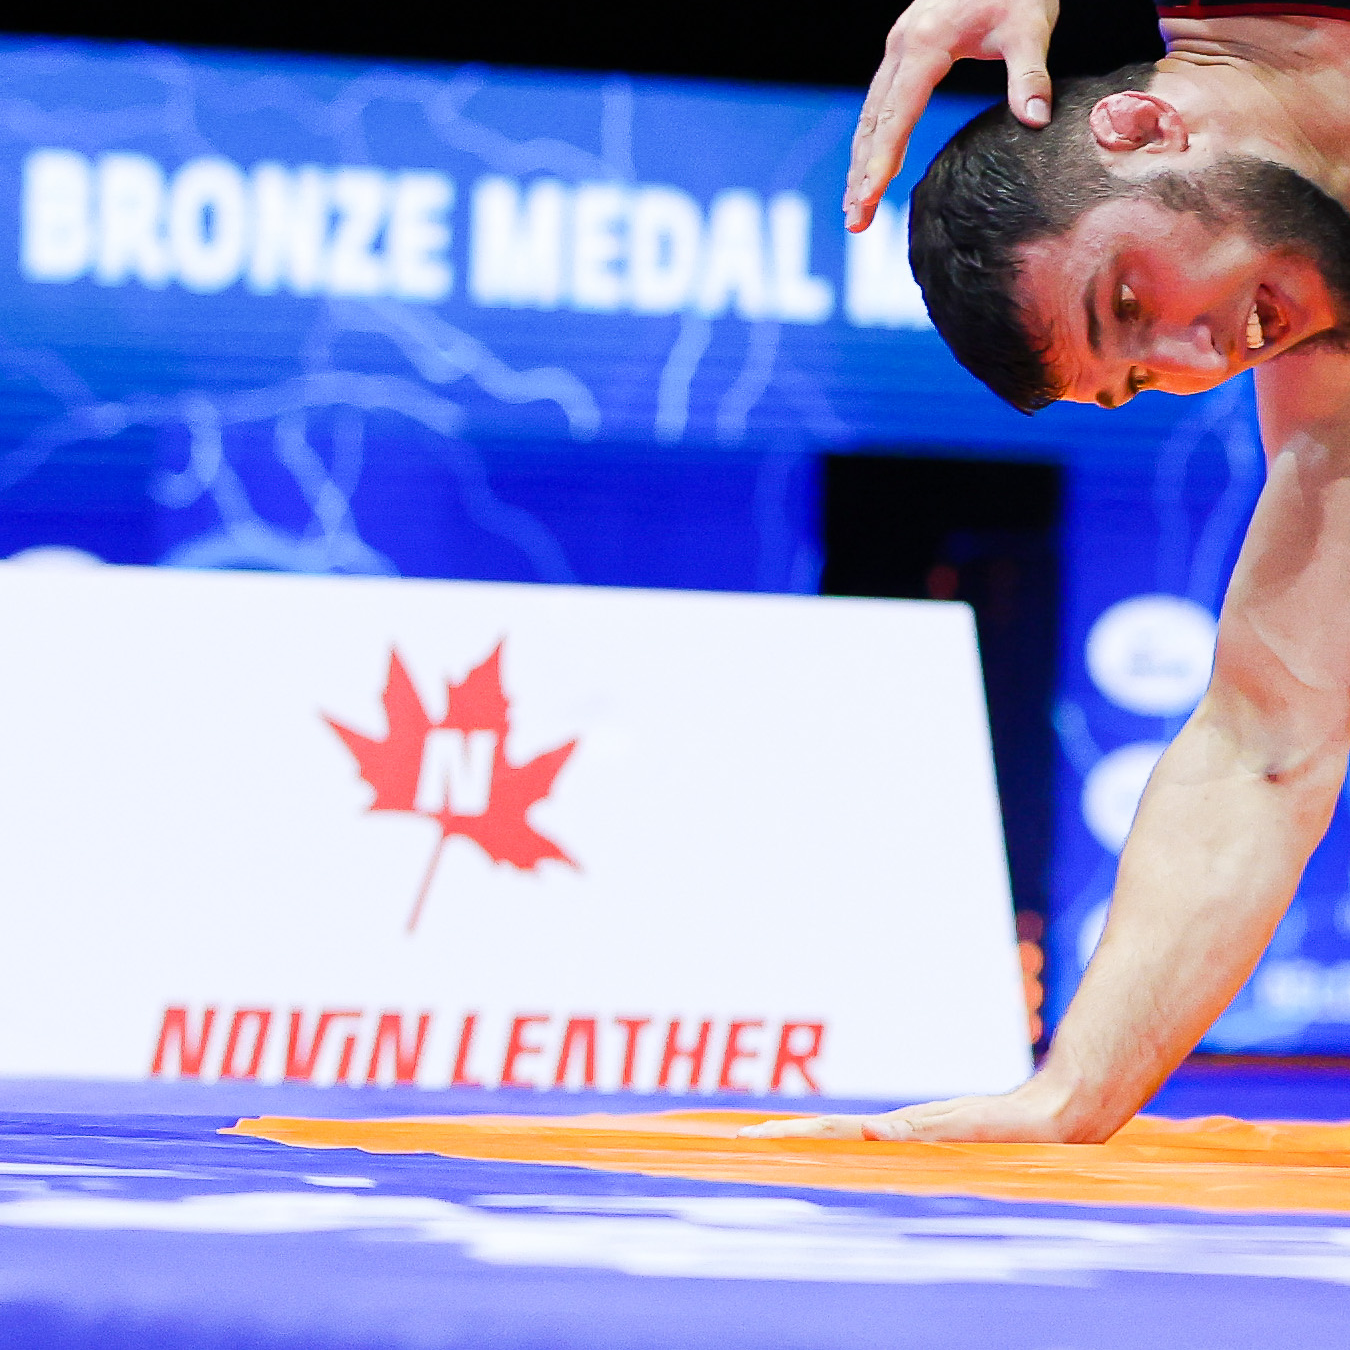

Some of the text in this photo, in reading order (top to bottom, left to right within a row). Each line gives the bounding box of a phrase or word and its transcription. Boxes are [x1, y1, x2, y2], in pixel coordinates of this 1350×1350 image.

[20, 148, 455, 302] BRONZE
[468, 175, 834, 324] MEDAL
[451, 1013, 826, 1094] LEATHER
